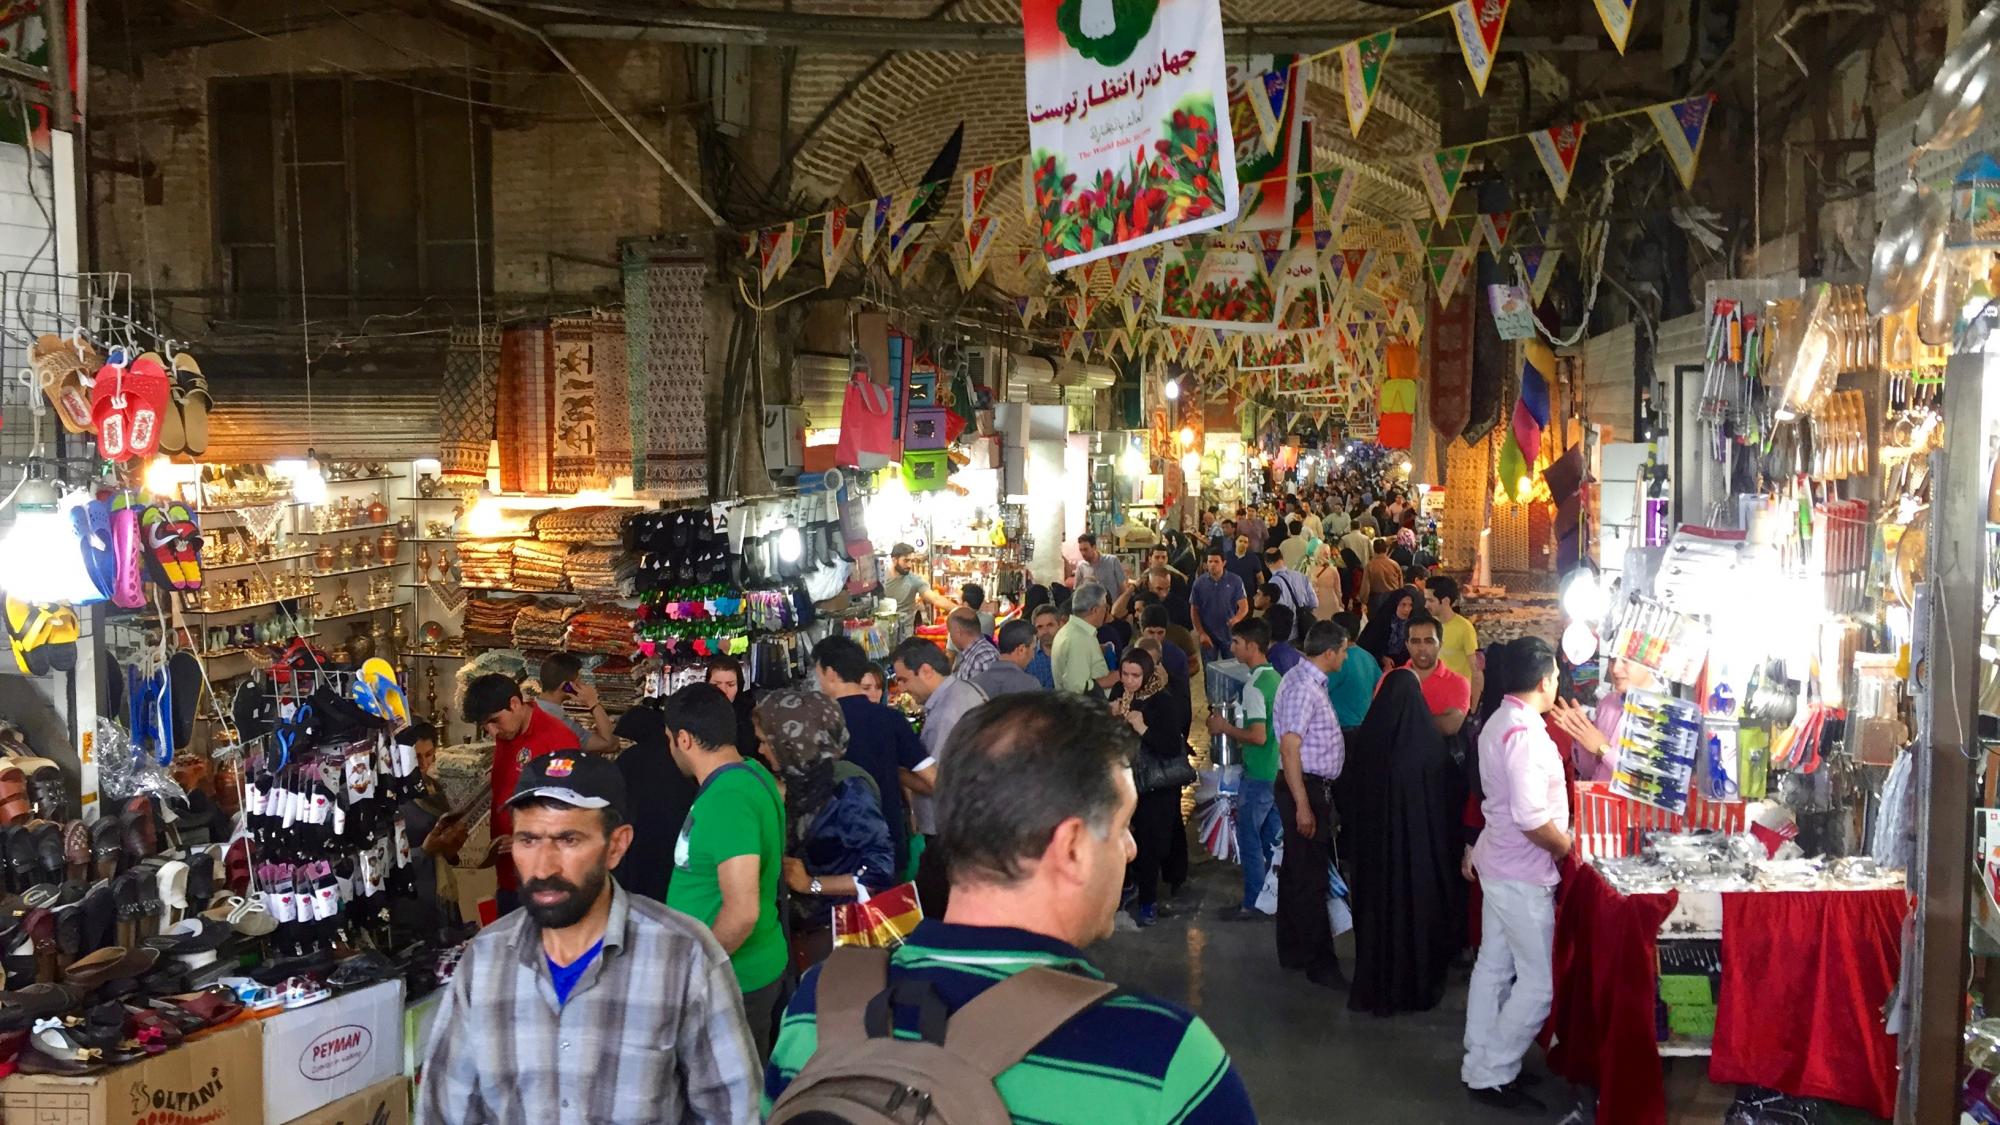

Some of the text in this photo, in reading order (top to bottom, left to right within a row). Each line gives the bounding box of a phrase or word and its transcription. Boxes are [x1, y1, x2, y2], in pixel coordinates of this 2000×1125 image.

[1030, 48, 1197, 124] جهان در انتظار توست
[312, 1031, 361, 1062] PEYMAN
